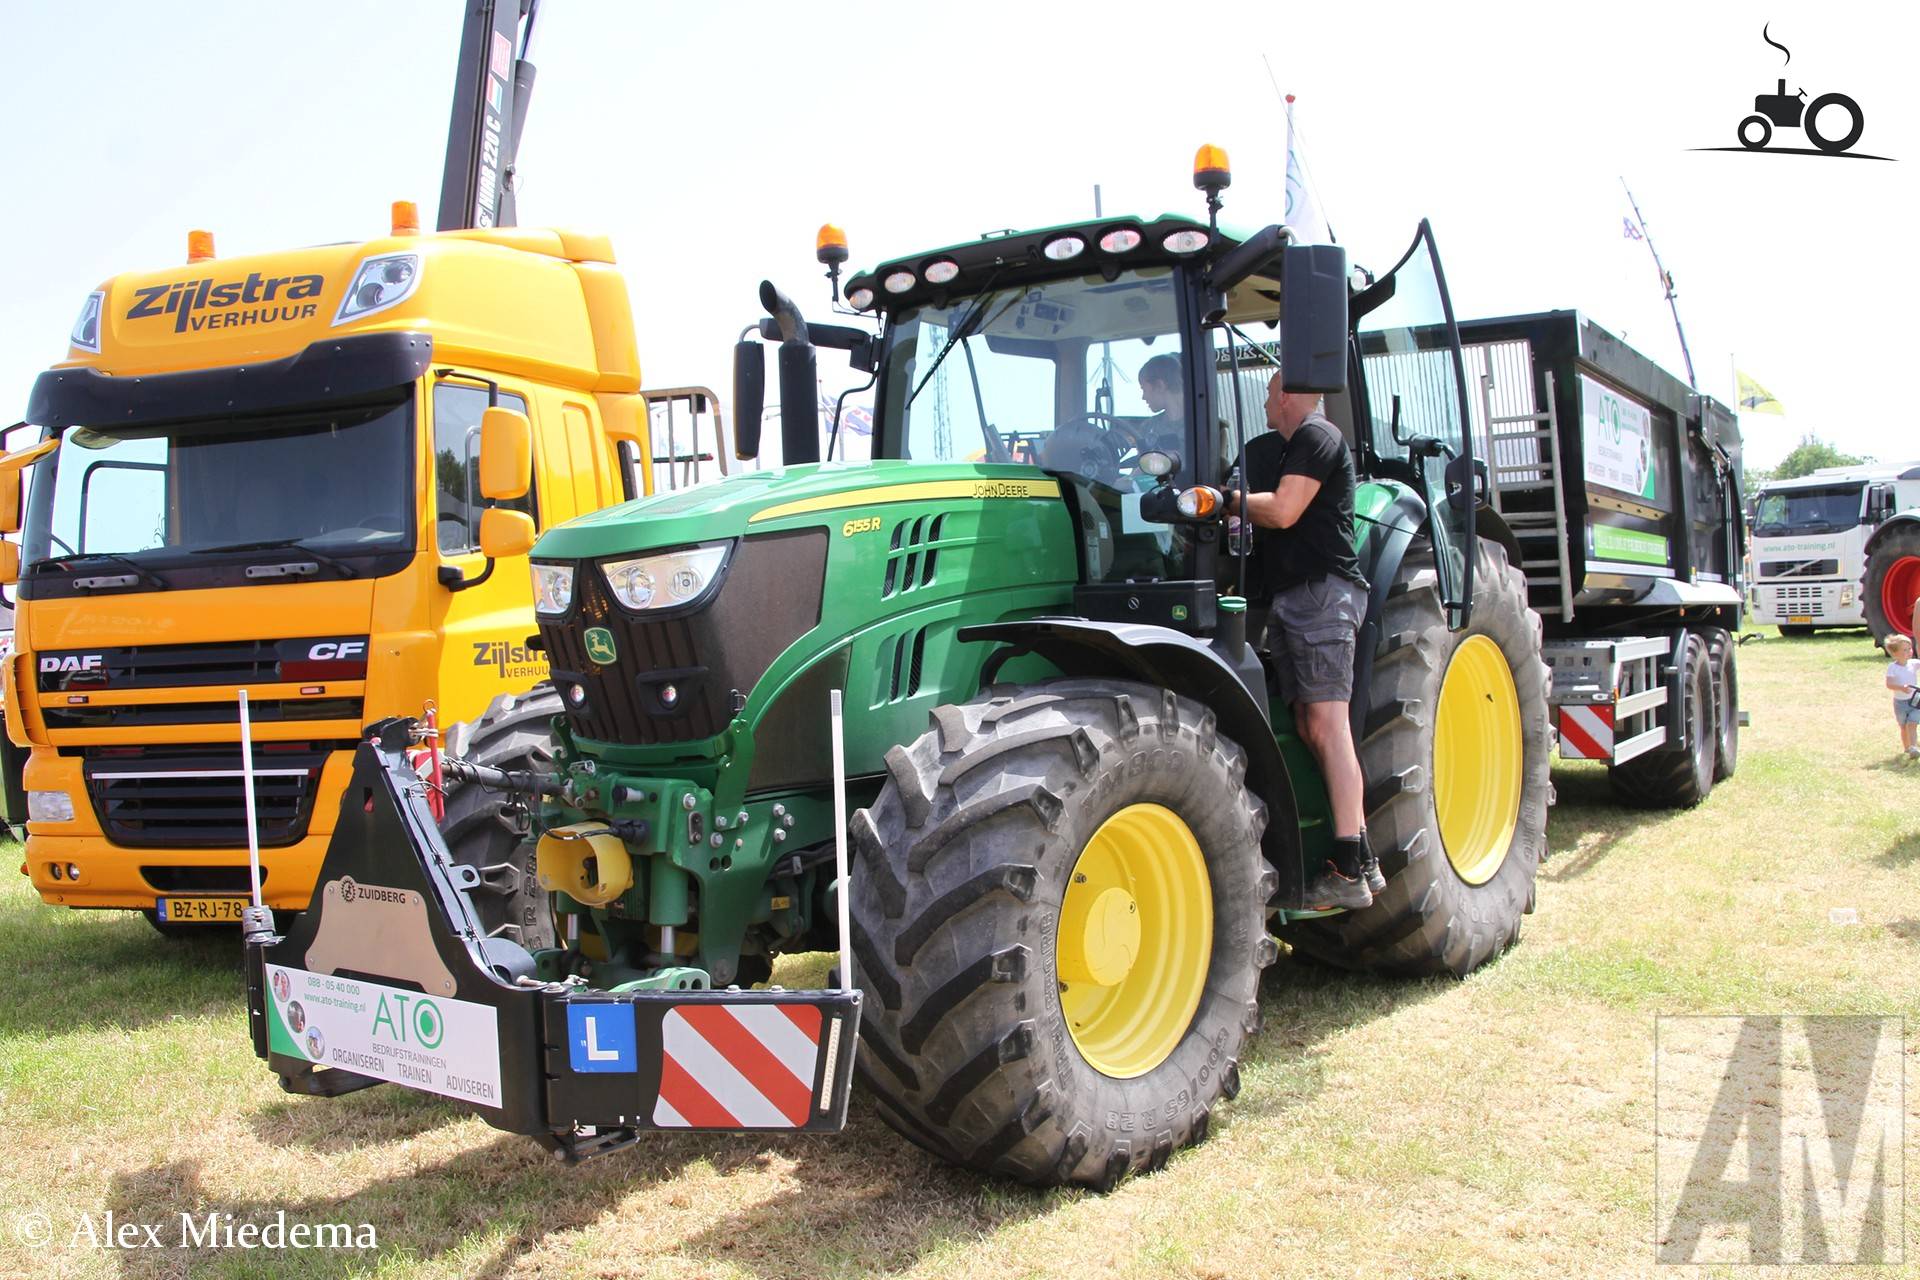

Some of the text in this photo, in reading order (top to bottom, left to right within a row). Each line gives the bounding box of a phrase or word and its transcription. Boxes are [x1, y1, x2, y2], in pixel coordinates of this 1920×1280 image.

[483, 131, 500, 168] 220
[479, 166, 497, 211] HIAB
[126, 272, 325, 334] Zijlstra
[190, 304, 318, 331] VERHUUR
[308, 641, 365, 660] CF
[40, 654, 102, 673] DAF
[506, 666, 549, 678] VERHUU
[358, 887, 406, 904] ZUIDBERG
[173, 901, 243, 918] BZ-RJ-78
[346, 984, 360, 996] 000
[304, 993, 366, 1014] www.ato-training.nl
[372, 991, 444, 1050] ATO
[585, 1016, 620, 1061] L
[332, 1048, 495, 1100] ORGANISEREN TRAINEN ADVISEREN
